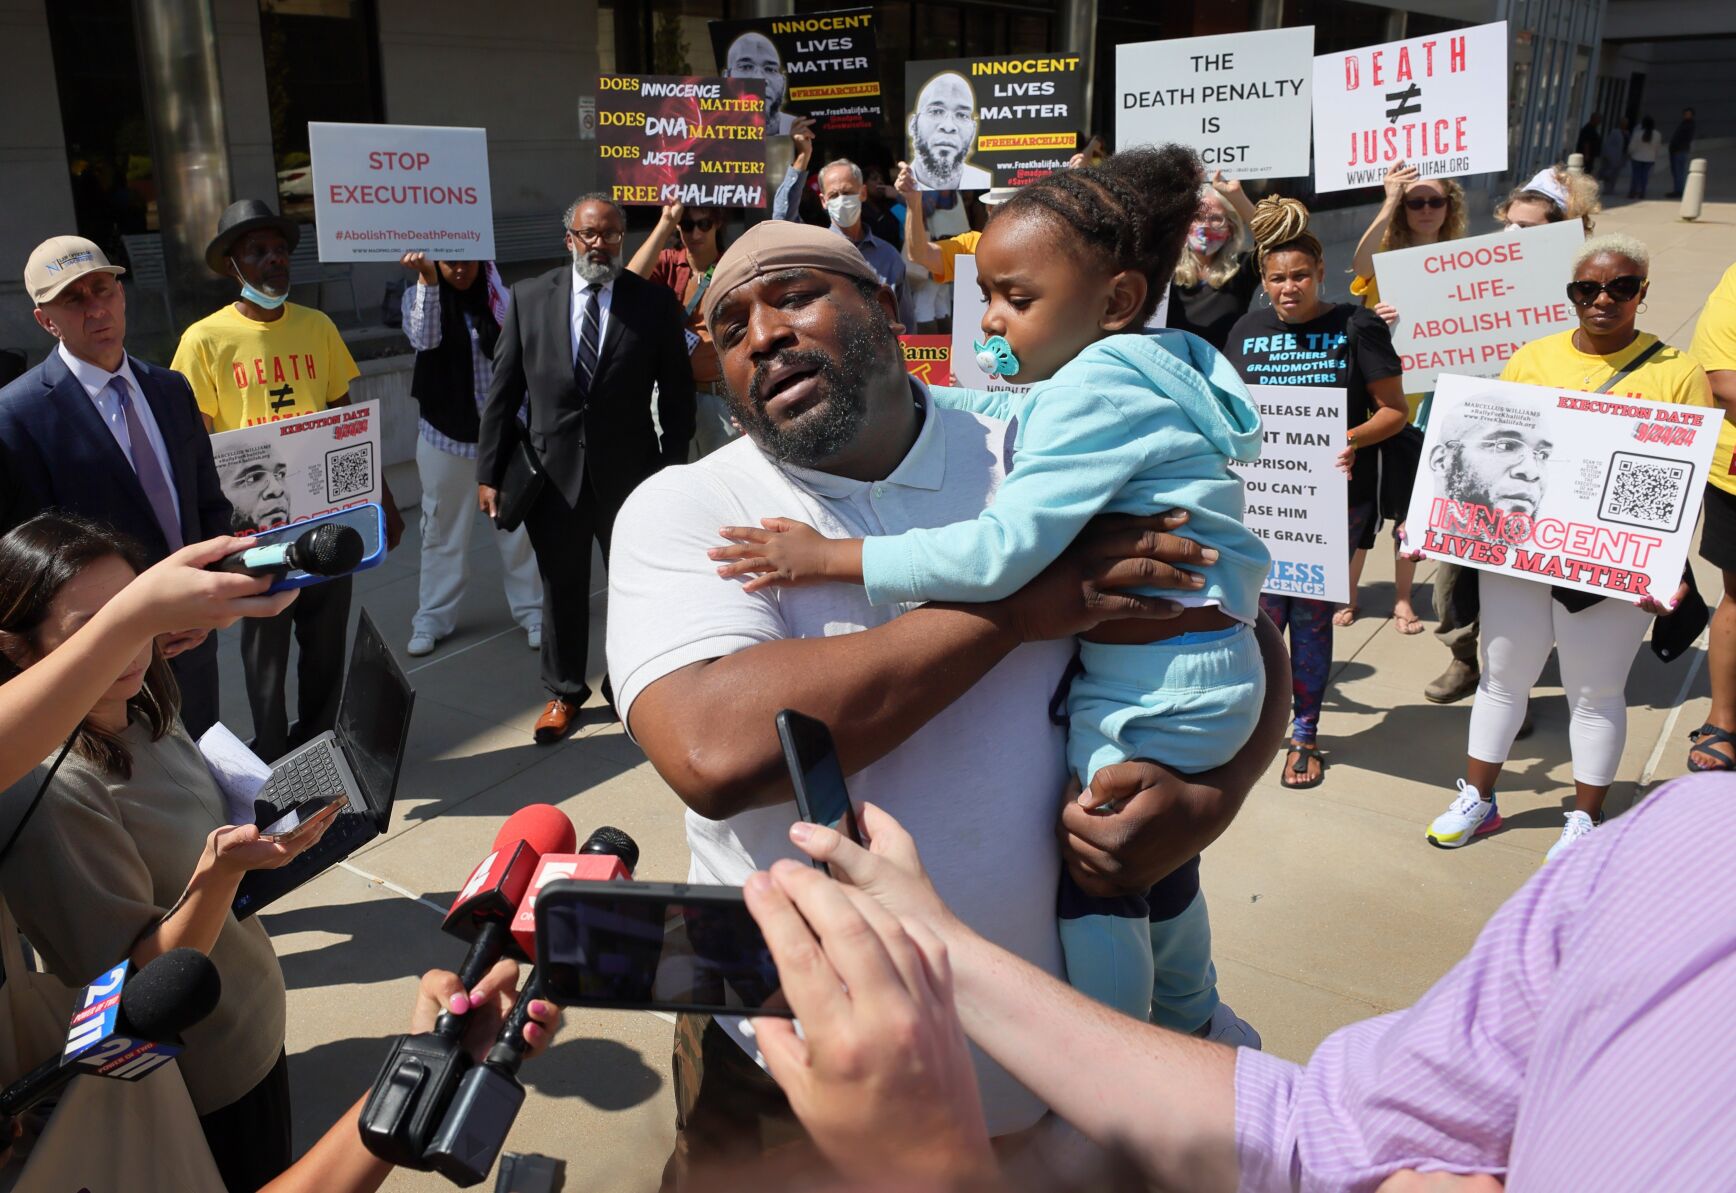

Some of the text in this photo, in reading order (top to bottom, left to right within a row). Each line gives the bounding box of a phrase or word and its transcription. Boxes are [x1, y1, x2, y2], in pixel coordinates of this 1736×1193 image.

[772, 15, 872, 34] INNOCENT
[796, 37, 853, 53] LIVES
[787, 57, 868, 73] MATTER
[972, 58, 1079, 75] INNOCENT
[1190, 53, 1234, 72] THE
[1345, 36, 1466, 91] DEATH
[600, 78, 764, 112] DOES INNOCENCE MATTER?
[994, 82, 1055, 97] LIVES
[1124, 79, 1304, 109] DEATH PENALTY
[981, 104, 1068, 120] MATTER
[600, 112, 764, 139] DOES DNA MATTER?
[1202, 117, 1220, 133] IS
[980, 136, 1075, 148] #FREEMARCELLUS
[1348, 117, 1467, 166] JUSTICE
[369, 152, 430, 170] STOP
[600, 146, 765, 174] DOES JUSTICE MATTER?
[997, 159, 1073, 170] www.FreeKhaliifah.or
[1202, 146, 1250, 164] CIST
[1347, 157, 1469, 185] WWW.FRLIIFAH.ORG
[329, 185, 478, 204] EXECUTIONS
[612, 184, 761, 206] FREE KHALIIFAH
[336, 230, 481, 241] #AbolishTheDeathPenalty
[1424, 243, 1523, 273] CHOOSE
[1448, 279, 1515, 301] -LIFE-
[1412, 304, 1568, 339] ABOLISH THE
[1243, 332, 1297, 355] FREE
[1246, 359, 1346, 372] GRANDMOTHES
[1269, 352, 1327, 361] MOTHERS
[1401, 349, 1475, 371] DEATH
[233, 354, 316, 389] DEATH
[1260, 373, 1336, 385] DAUGHTERS
[1259, 404, 1339, 418] ELEASE AN
[1557, 397, 1704, 426] EXECUTION DATE
[280, 416, 341, 436] EXECUTION
[343, 408, 370, 422] DATE
[1286, 432, 1330, 447] MAN
[1254, 458, 1312, 473] PRISON,
[1247, 481, 1317, 497] OU CAN'T
[1278, 507, 1307, 519] HIM
[1250, 528, 1327, 545] HE GRAVE.
[1428, 497, 1662, 568] INNOCENT
[1422, 530, 1651, 596] LIVES MATTER
[84, 967, 124, 1008] 2
[77, 1038, 132, 1066] 2
